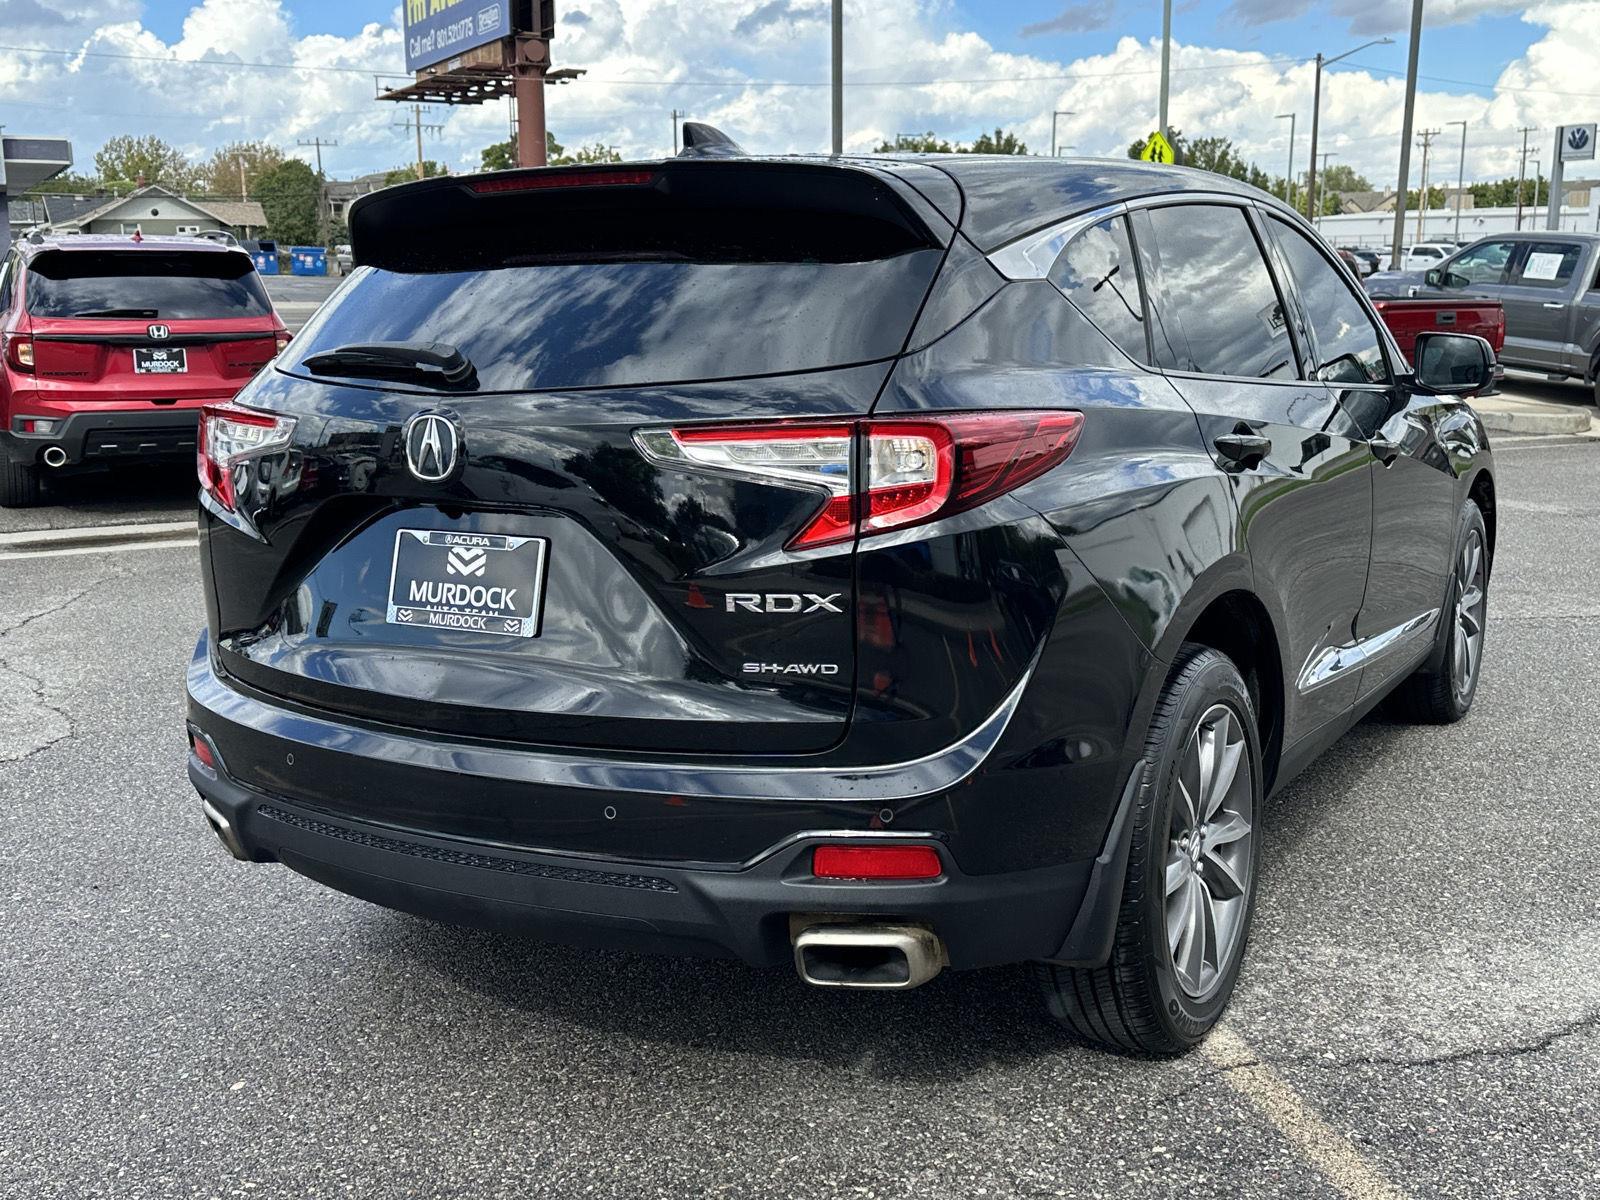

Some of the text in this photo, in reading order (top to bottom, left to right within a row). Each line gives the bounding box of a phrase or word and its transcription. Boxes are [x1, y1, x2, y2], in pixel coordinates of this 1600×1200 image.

[409, 36, 421, 58] Call
[421, 29, 435, 53] me?
[141, 360, 180, 368] MURDOCK
[452, 535, 490, 546] ACURA
[408, 580, 518, 610] MURDOCK
[725, 593, 843, 613] RDX
[429, 612, 487, 630] MURDOCK
[742, 662, 839, 675] SH-AWD
